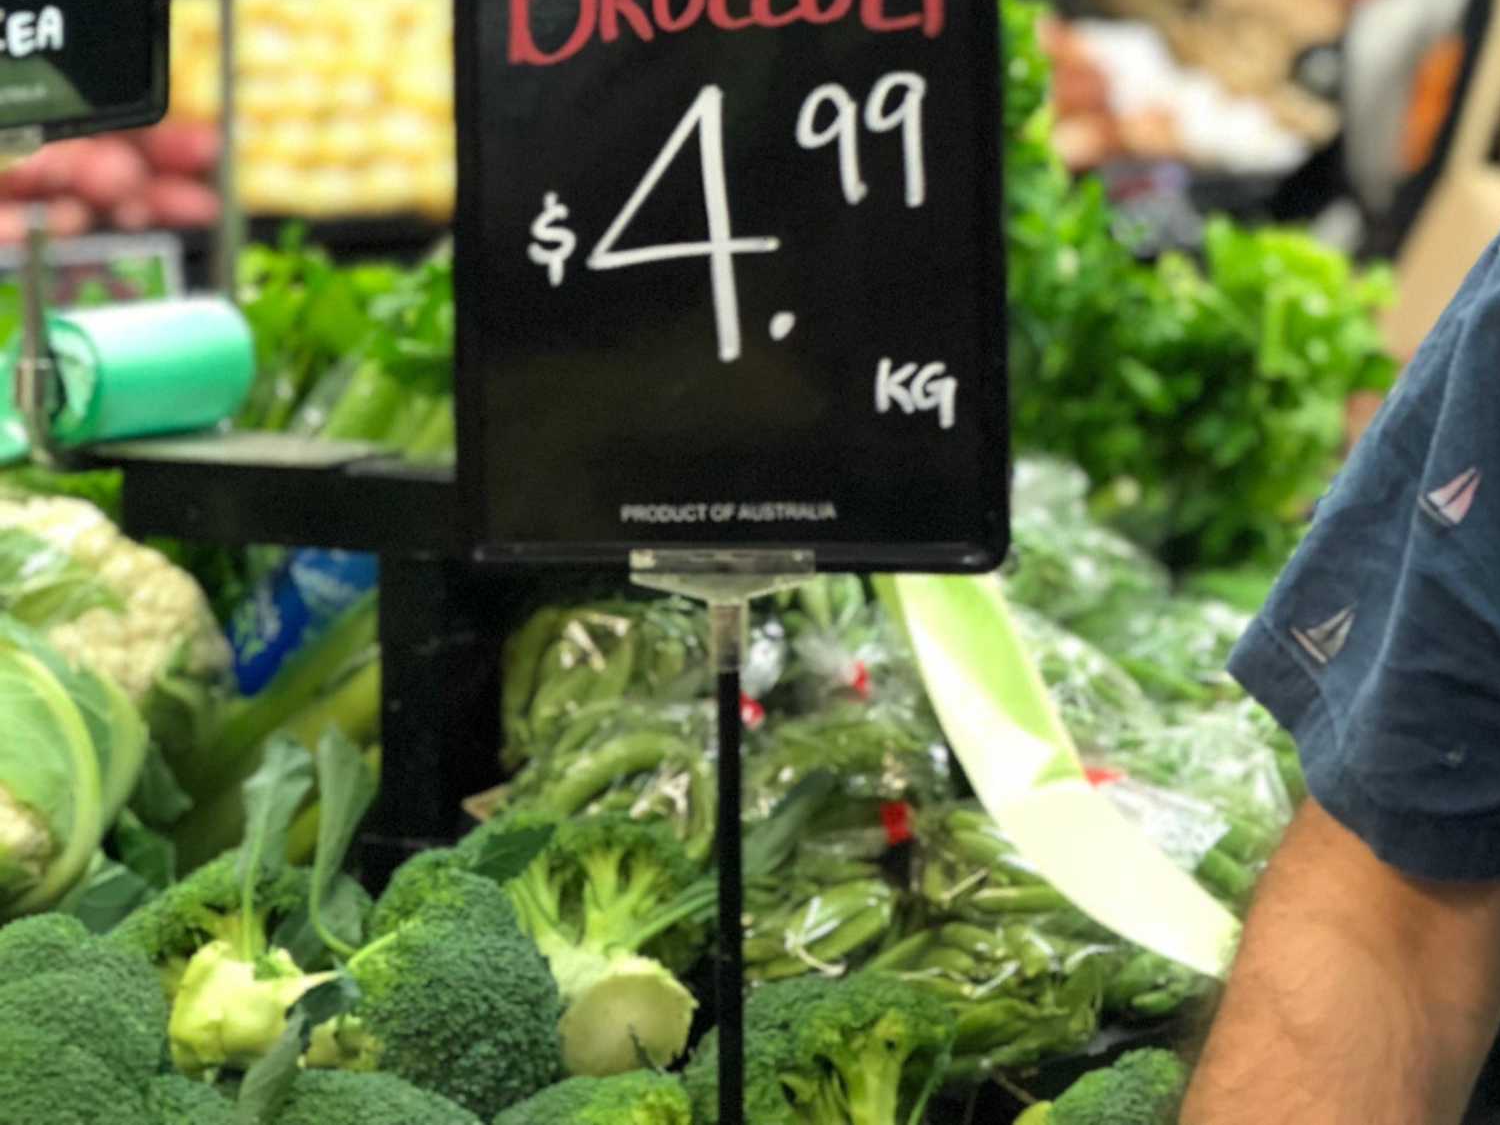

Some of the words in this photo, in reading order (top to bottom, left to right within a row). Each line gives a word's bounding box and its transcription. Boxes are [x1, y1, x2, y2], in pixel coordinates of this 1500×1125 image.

[874, 357, 957, 430] KG
[620, 503, 707, 523] PRODUCT
[710, 503, 735, 522] OF
[738, 501, 837, 521] AUSTRALIA
